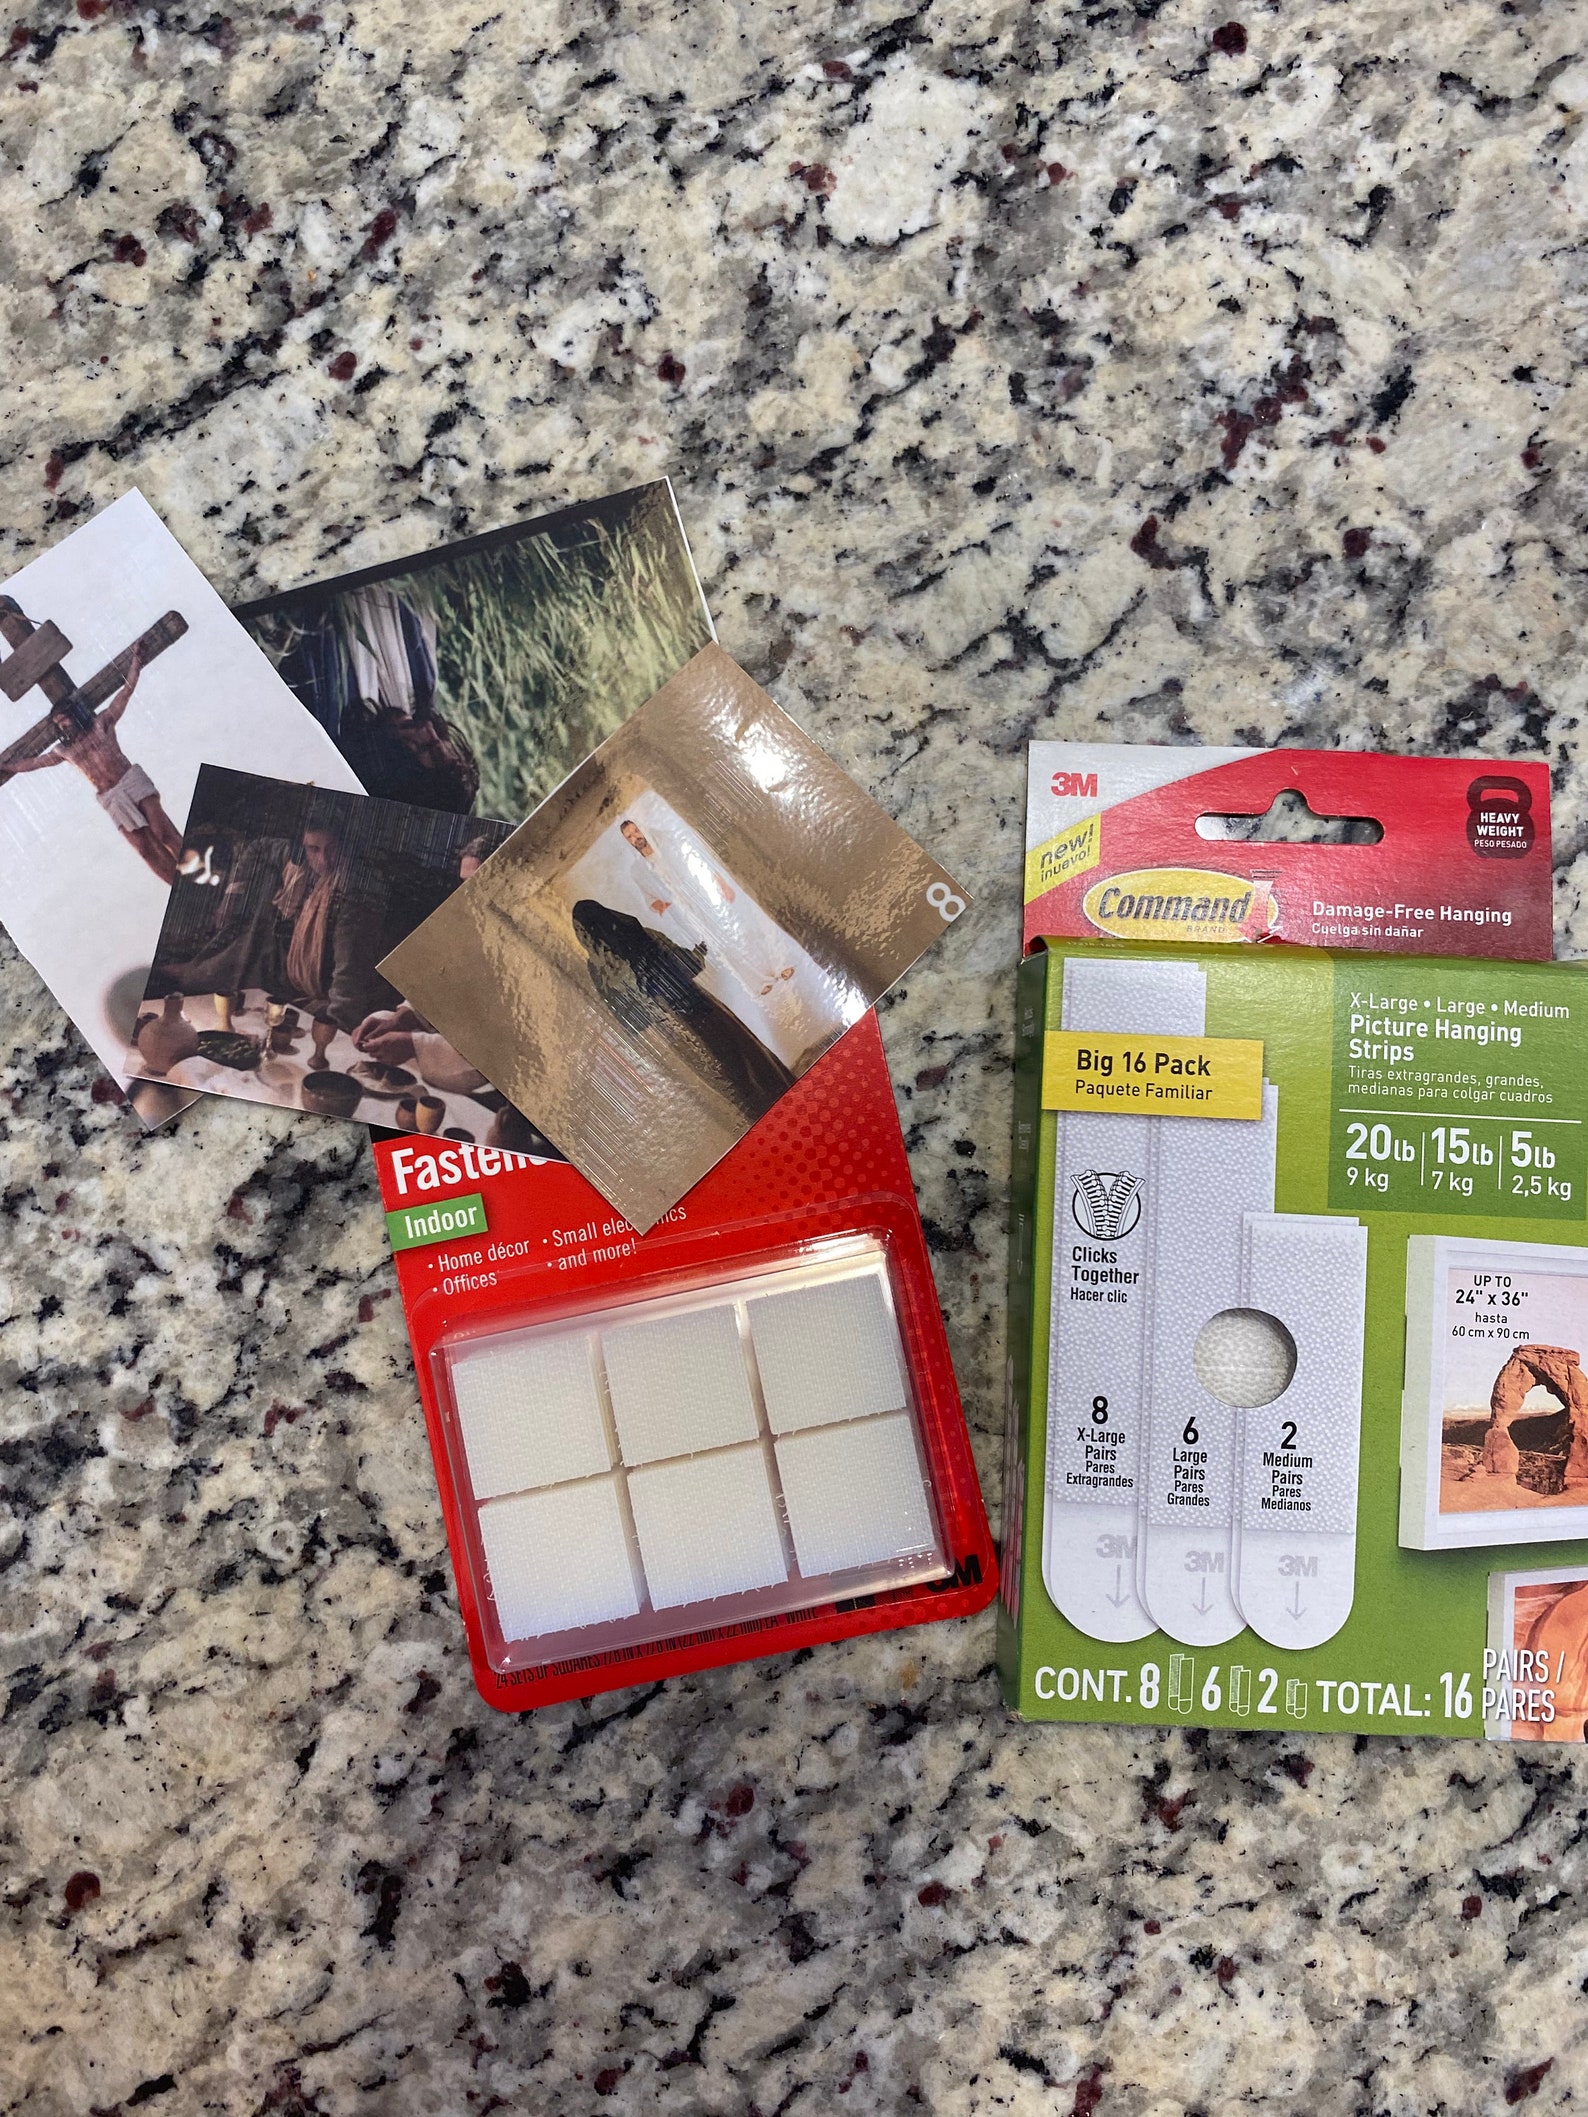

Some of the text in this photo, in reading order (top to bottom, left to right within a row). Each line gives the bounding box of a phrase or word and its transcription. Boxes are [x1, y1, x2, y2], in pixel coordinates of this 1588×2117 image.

[1051, 772, 1098, 797] 3M
[1480, 812, 1519, 824] HEAVY
[1476, 825, 1524, 837] WEIGHT
[1041, 824, 1093, 869] new!
[1474, 839, 1527, 849] PESO PESADO
[926, 882, 966, 922] 8
[1098, 888, 1252, 923] Command
[1312, 901, 1512, 927] Damage-Free Hanging
[1186, 925, 1226, 934] BRAND
[1311, 923, 1424, 938] Cuelga sin dañar
[1350, 992, 1570, 1019] X-Large Large Medium
[1350, 1014, 1522, 1047] Picture Hanging
[1077, 1049, 1212, 1077] Big 16 Pack
[1349, 1039, 1415, 1065] Strips
[1349, 1066, 1544, 1089] Tiras extragrandes, grandes,
[1075, 1080, 1213, 1100] Paquete Familiar
[1348, 1083, 1553, 1104] medianas para colgar cuadros
[1347, 1166, 1389, 1192] 9 kg
[1431, 1171, 1473, 1196] 7 kg
[1511, 1175, 1572, 1201] 2,5 kg
[404, 1205, 478, 1239] Indoor
[552, 1222, 599, 1247] Small
[438, 1238, 530, 1273] Home décor
[558, 1238, 638, 1271] and more!
[1072, 1245, 1118, 1264] Clicks
[443, 1271, 498, 1296] Offices
[1071, 1265, 1139, 1286] Together
[1473, 1274, 1512, 1288] UP TO
[1070, 1287, 1128, 1304] Hacer clic
[1455, 1289, 1529, 1306] 24" x 36"
[1475, 1312, 1508, 1324] hasta
[1452, 1326, 1530, 1340] 60 cm x 90 cm
[1092, 1395, 1109, 1425] 8
[1077, 1427, 1126, 1445] X-Large
[1182, 1416, 1199, 1445] 6
[1281, 1421, 1298, 1450] 2
[1085, 1445, 1117, 1461] Pairs
[1172, 1447, 1208, 1464] Large
[1262, 1452, 1313, 1469] Medium
[1085, 1460, 1115, 1474] Pares
[1174, 1465, 1206, 1481] Pairs
[1271, 1470, 1303, 1486] Pairs
[1066, 1472, 1134, 1489] Extragrandes
[1174, 1480, 1204, 1494] Pares
[1272, 1485, 1301, 1498] Pares
[1167, 1493, 1210, 1507] Grandes
[1261, 1498, 1312, 1512] Medianos
[1184, 1551, 1225, 1574] 3M
[1277, 1554, 1319, 1577] 3M
[1482, 1647, 1549, 1683] PAIRS
[1034, 1662, 1473, 1719] CONT. 8 6 2 TOTAL: 16
[1481, 1687, 1556, 1723] PARES
